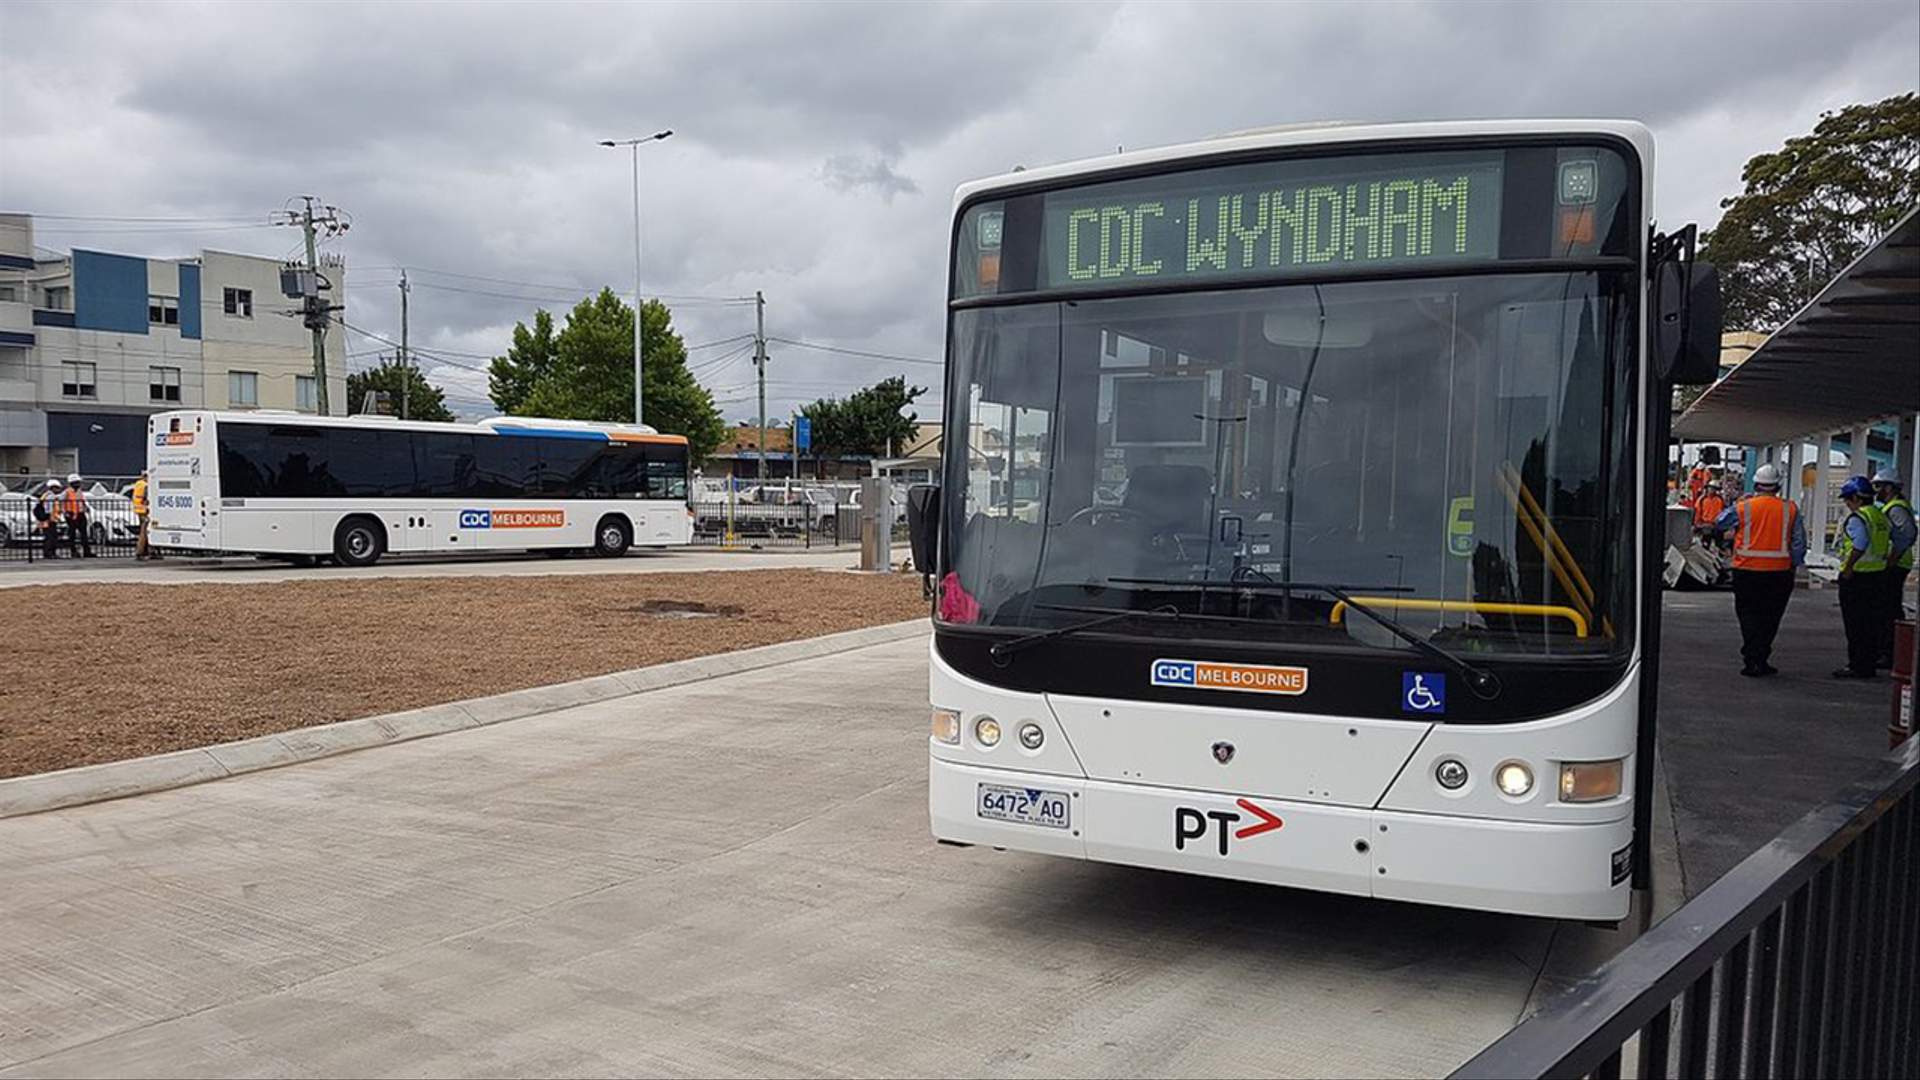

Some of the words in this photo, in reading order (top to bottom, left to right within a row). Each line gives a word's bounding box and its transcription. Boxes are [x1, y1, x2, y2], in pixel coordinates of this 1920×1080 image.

[1068, 202, 1164, 280] CDC
[1186, 176, 1469, 272] WYNDHAM
[461, 513, 488, 526] CDC
[493, 513, 563, 525] MELBOURNE
[1157, 664, 1192, 681] CDC
[1199, 669, 1301, 688] MELBOURNE
[983, 792, 1029, 815] 6472
